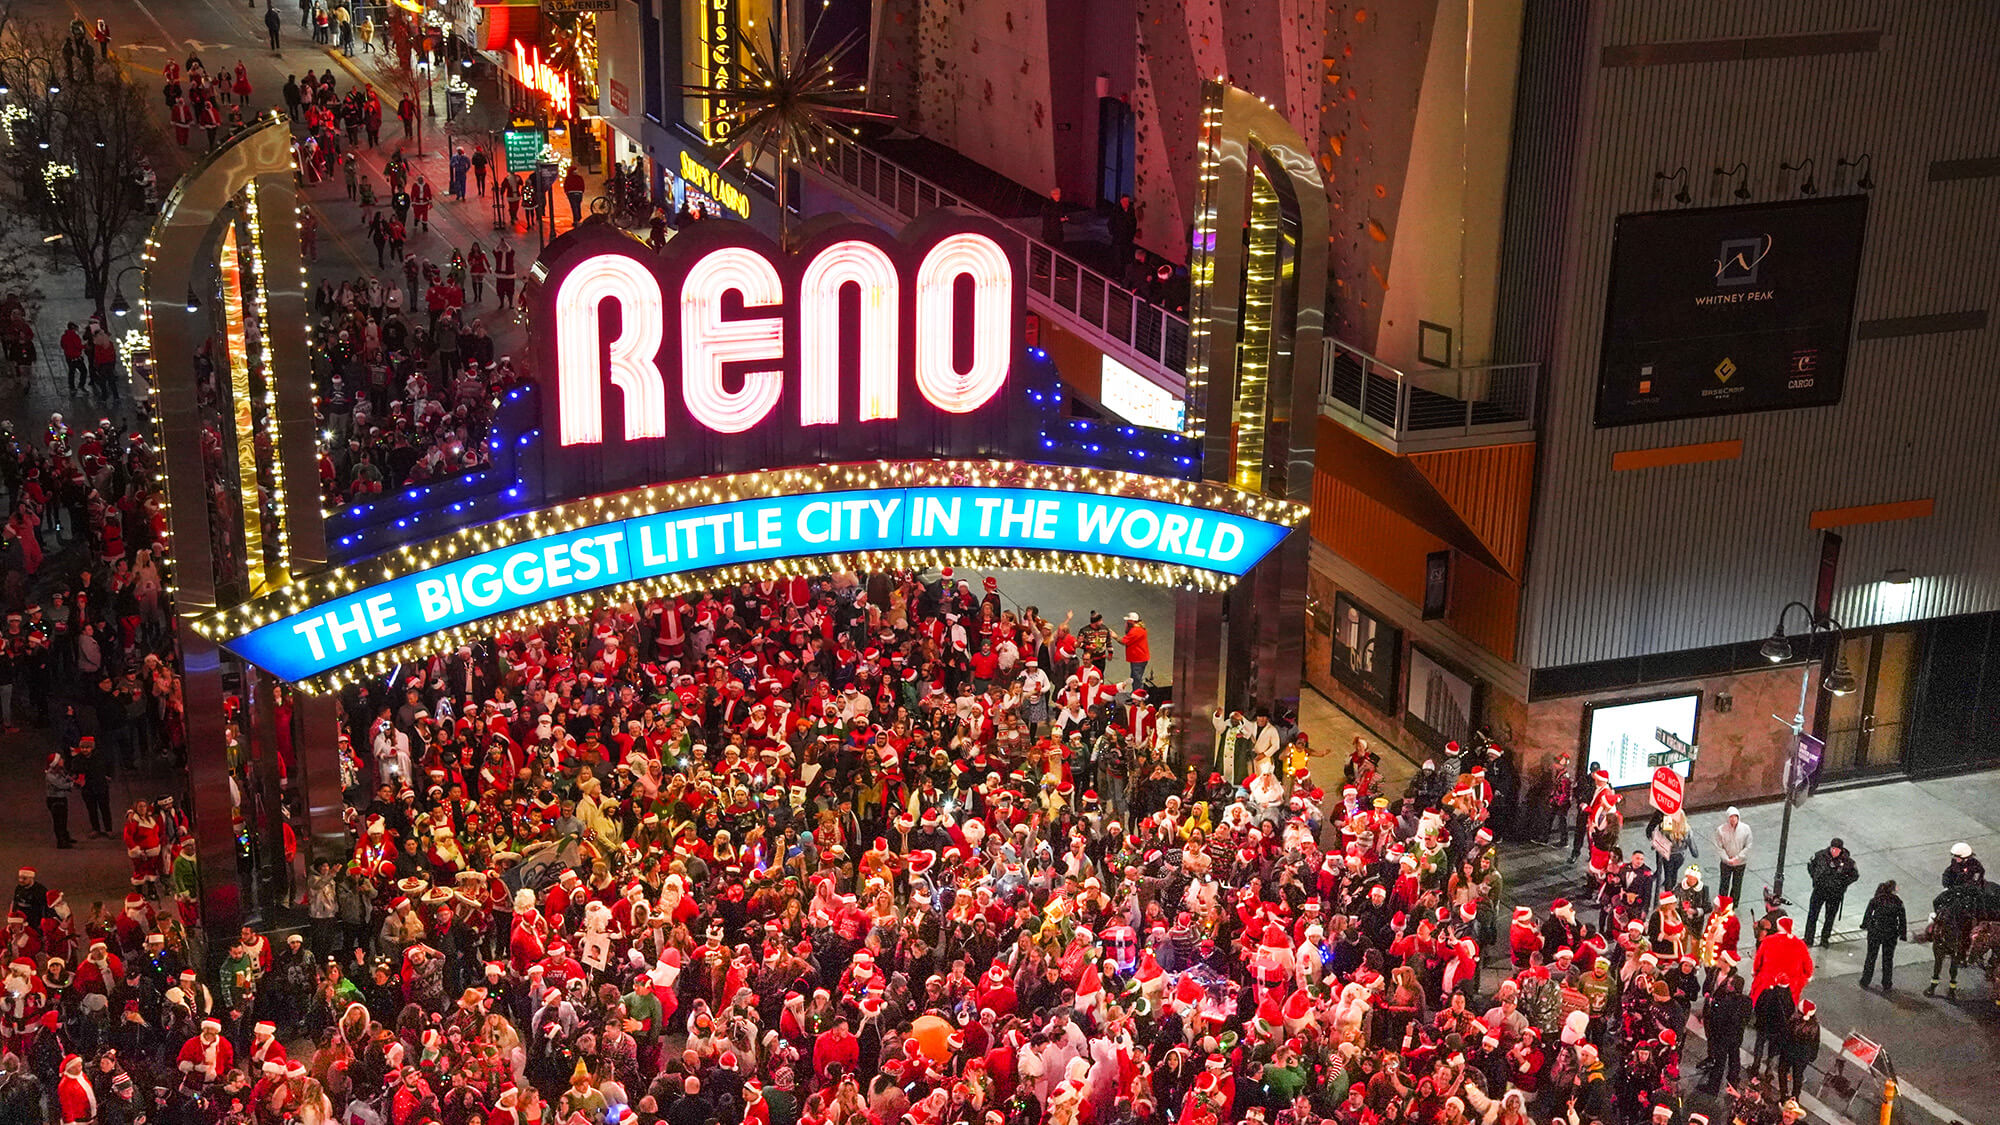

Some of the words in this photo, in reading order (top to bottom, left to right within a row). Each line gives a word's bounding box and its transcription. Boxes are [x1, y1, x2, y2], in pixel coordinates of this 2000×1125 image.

[711, 172, 750, 220] CASINO
[1694, 292, 1745, 306] WHITNEY
[1747, 289, 1775, 302] PEAK
[555, 231, 1013, 447] RENO
[1787, 378, 1814, 390] CARGO
[293, 593, 402, 661] THE
[416, 532, 624, 623] BIGGEST
[641, 508, 782, 567] LITTLE
[797, 499, 902, 544] CITY
[911, 497, 962, 537] IN
[975, 498, 1061, 540] THE
[1077, 503, 1245, 562] WORLD
[1657, 770, 1666, 781] DO
[1667, 776, 1679, 789] NOT
[1657, 793, 1675, 810] ENTER
